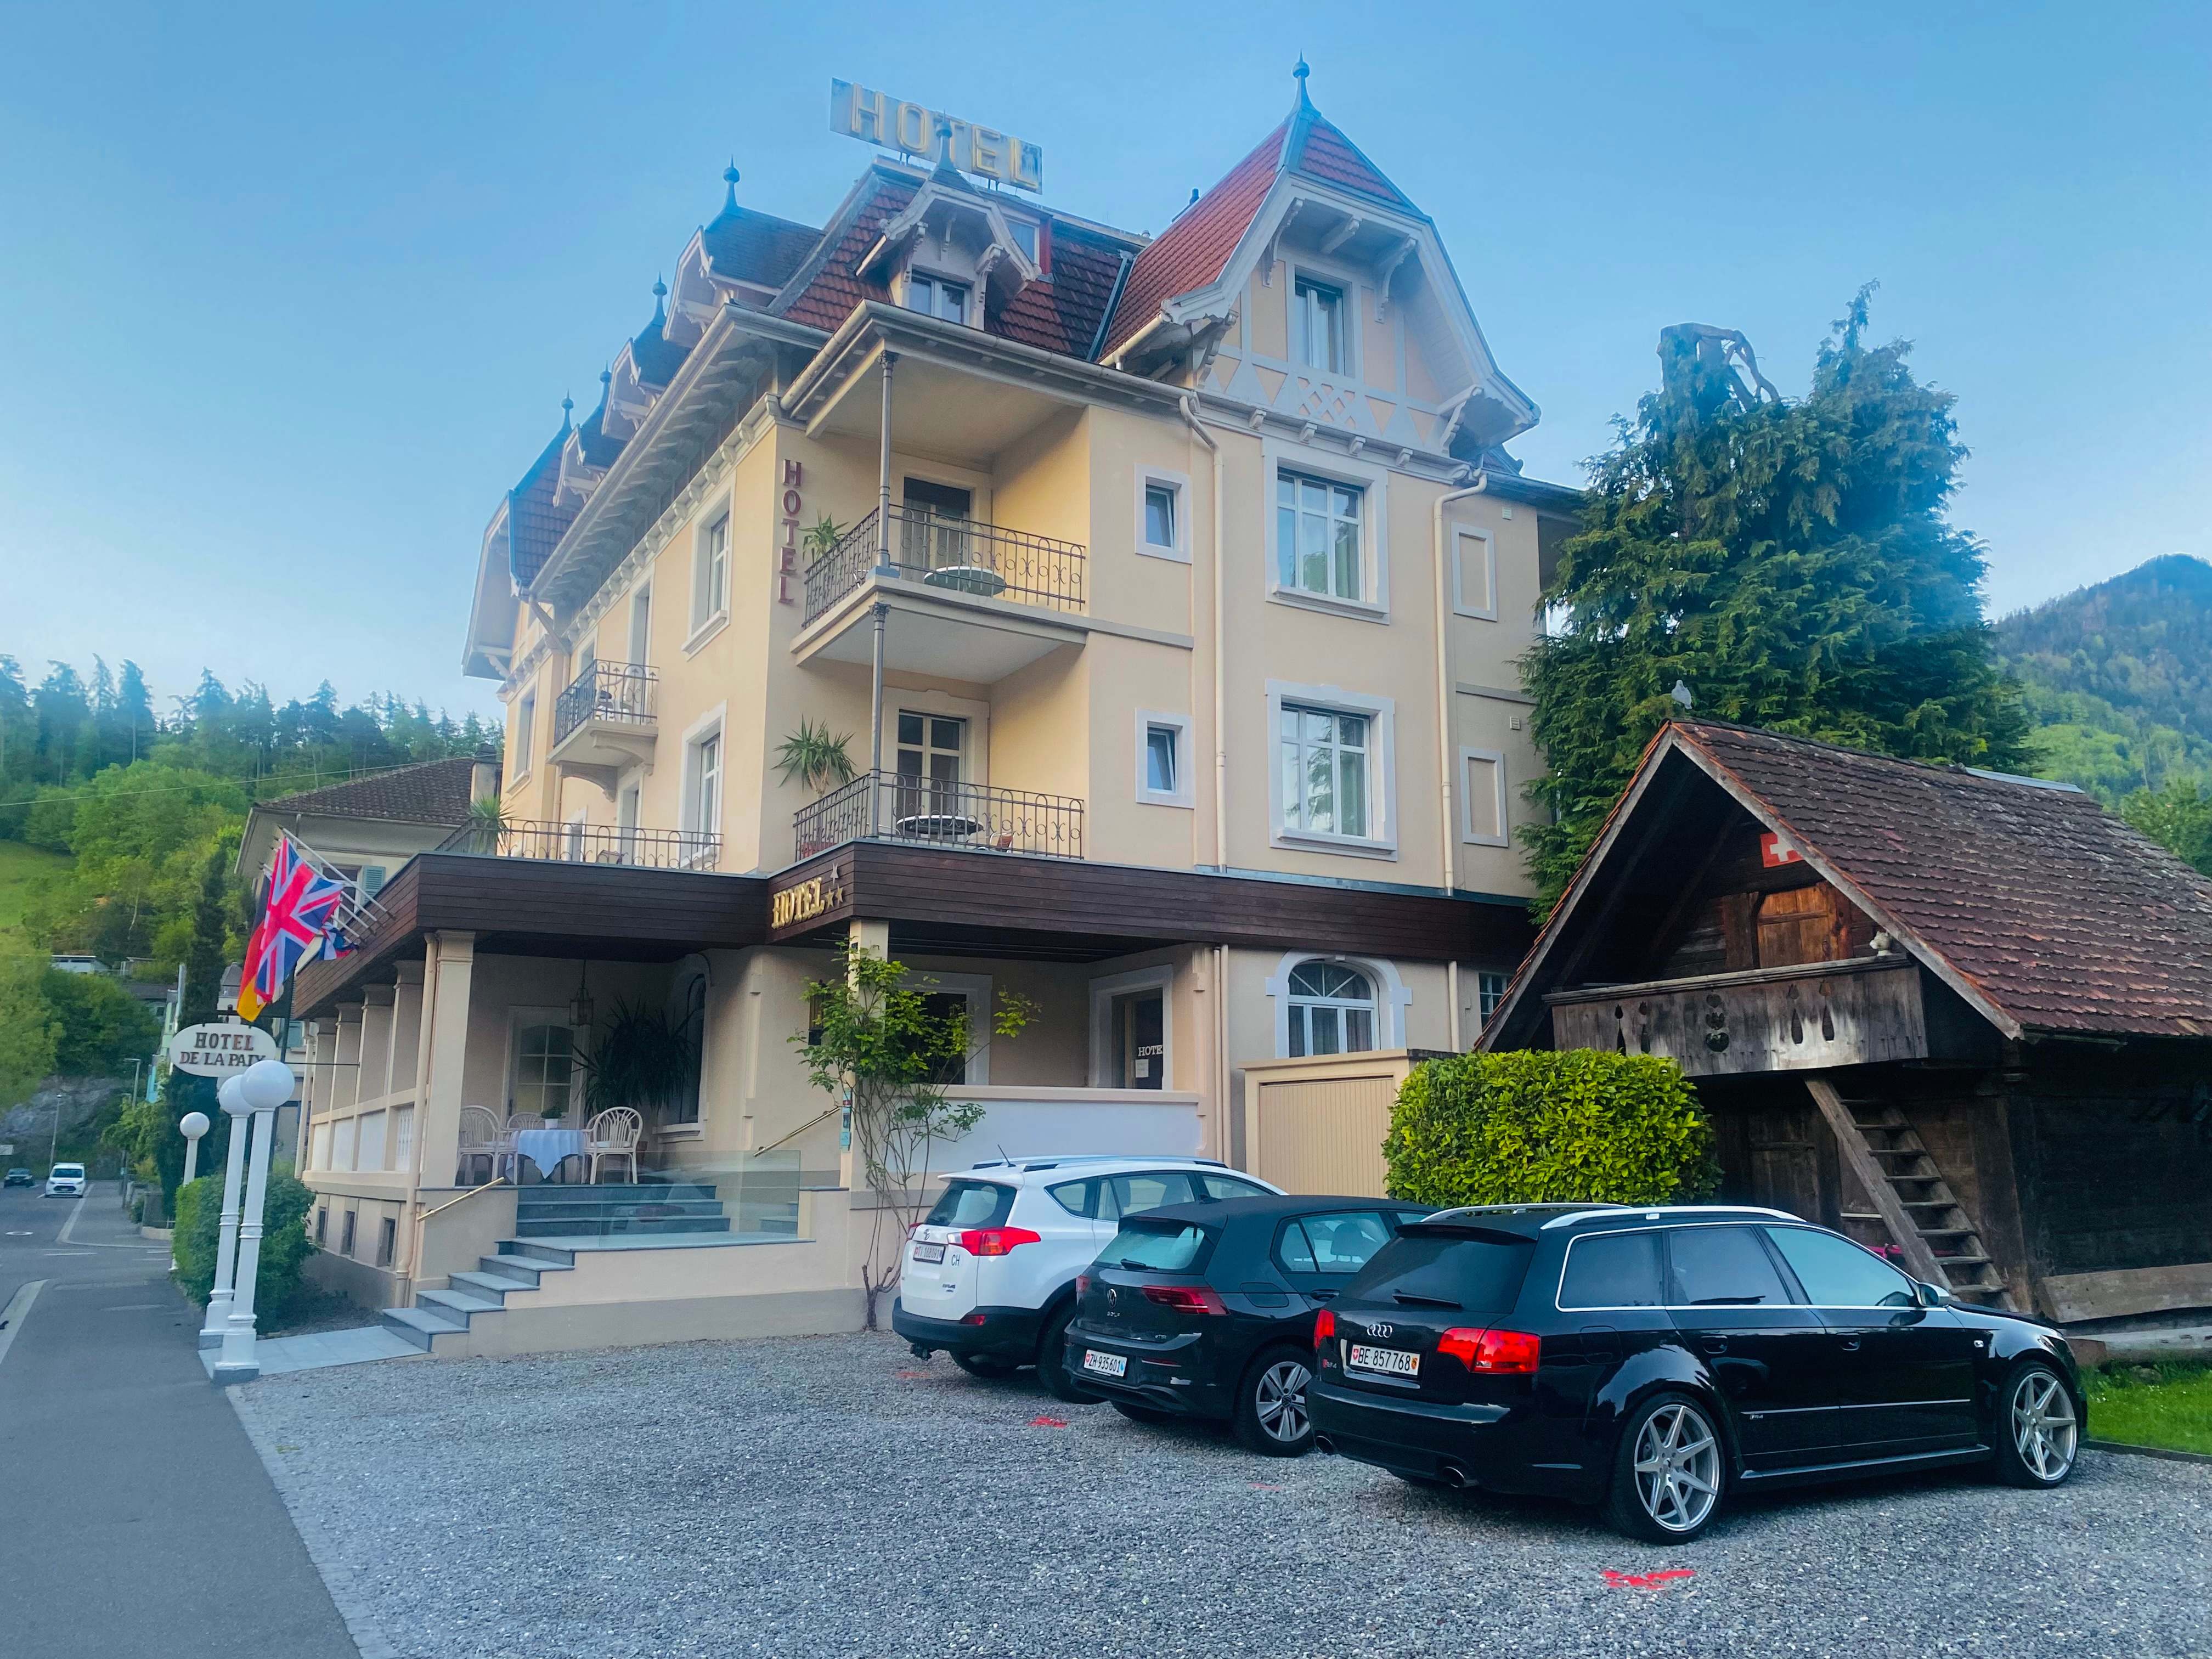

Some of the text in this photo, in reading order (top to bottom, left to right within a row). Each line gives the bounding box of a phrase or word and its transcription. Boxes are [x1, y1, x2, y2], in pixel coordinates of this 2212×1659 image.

[851, 82, 1038, 190] HOTEL
[778, 459, 802, 603] HOTEL
[771, 877, 825, 929] HOTEL
[194, 1032, 254, 1051] HOTEL
[1138, 1045, 1163, 1057] HOTE
[179, 1052, 199, 1064] DE
[204, 1052, 224, 1066] LA
[951, 1254, 961, 1266] CH
[1089, 1353, 1120, 1373] ZH 935601
[1358, 1347, 1410, 1371] BE 857768
